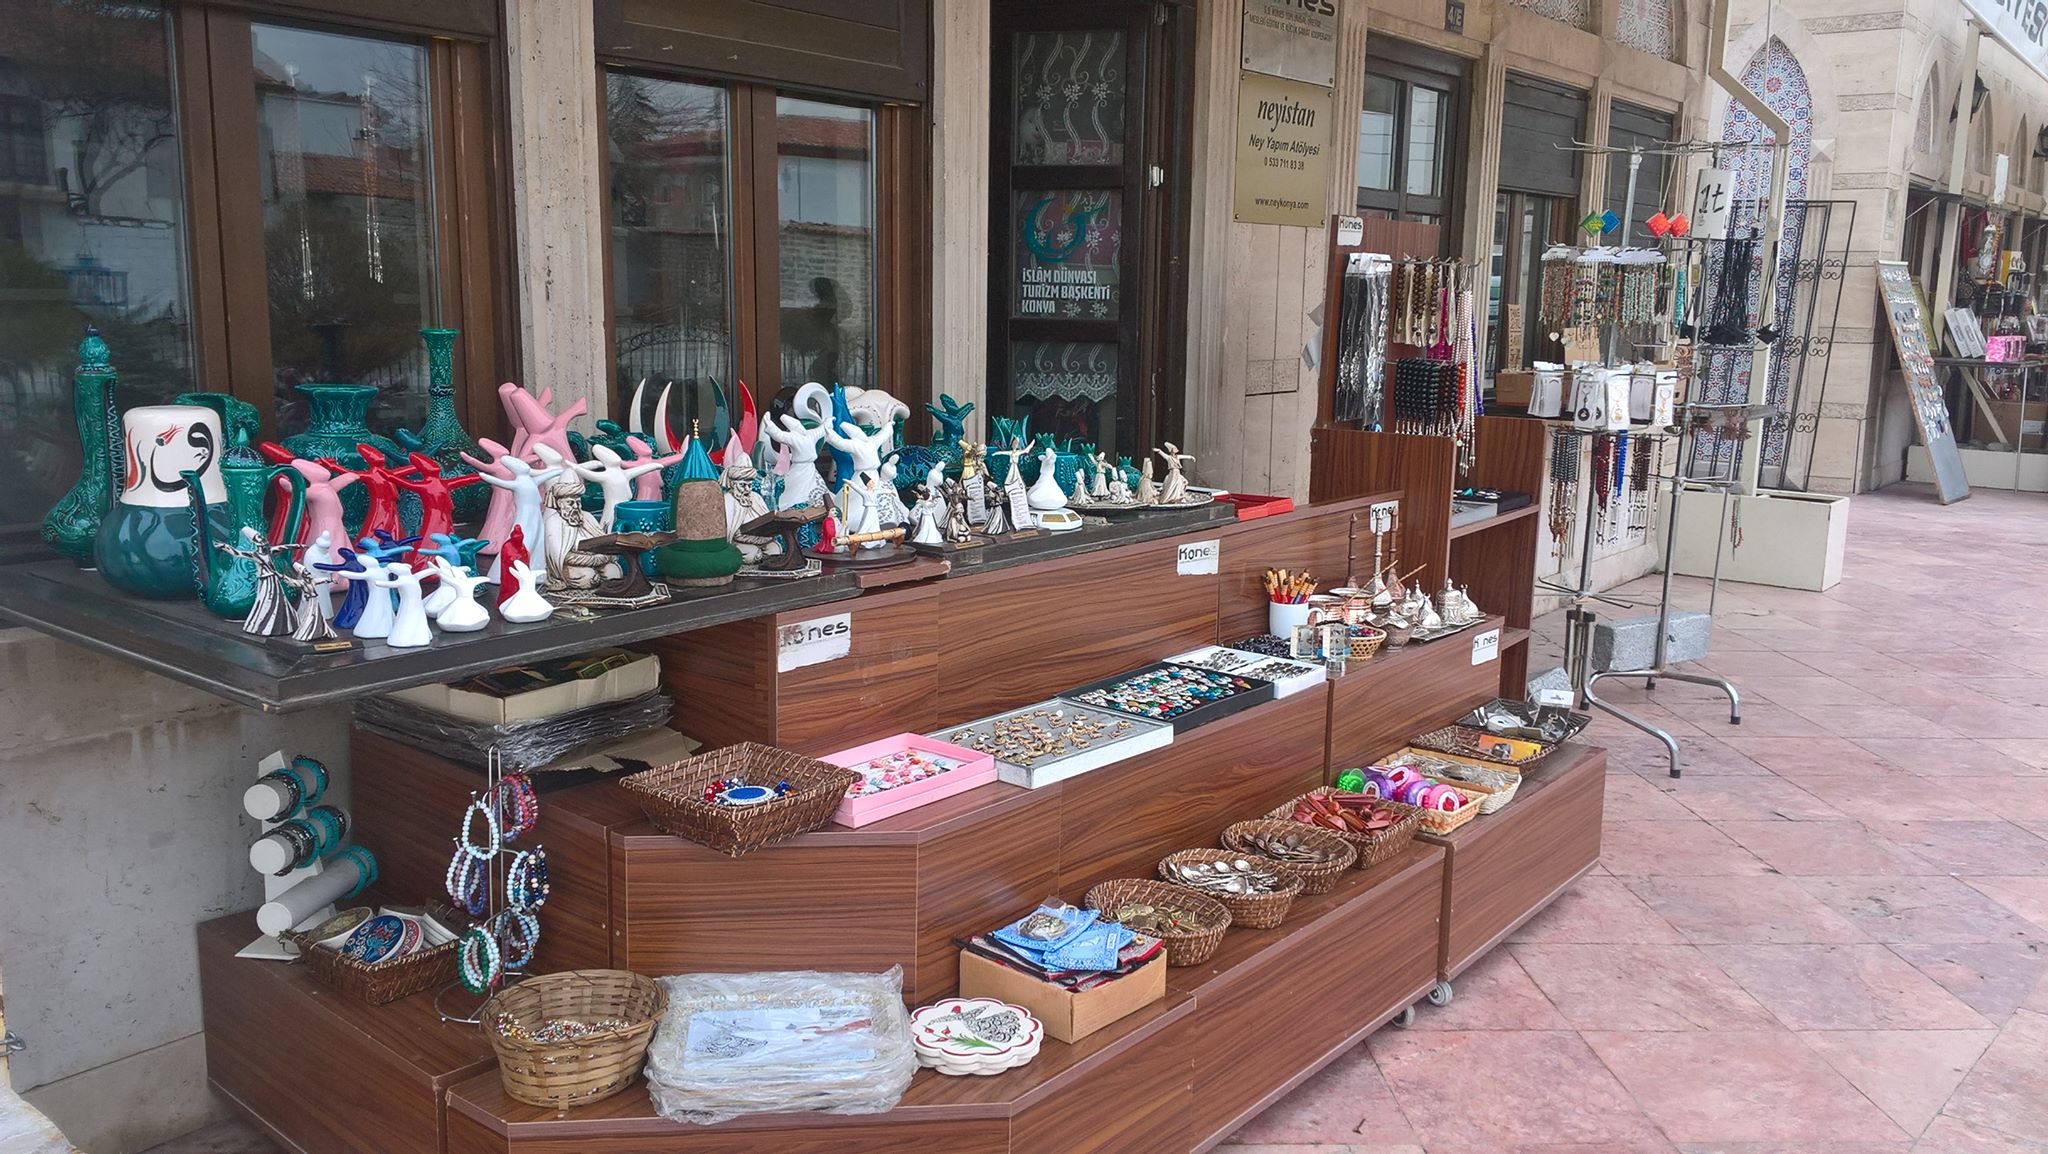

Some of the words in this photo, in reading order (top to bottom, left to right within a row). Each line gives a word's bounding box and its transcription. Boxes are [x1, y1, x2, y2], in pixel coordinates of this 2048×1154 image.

[1257, 95, 1316, 132] neyistan
[1248, 133, 1265, 151] Ney
[1266, 136, 1289, 153] Yapım
[1289, 140, 1321, 157] Atölyesi
[1264, 156, 1268, 167] 0
[1269, 157, 1279, 167] 533
[1280, 158, 1289, 169] 711
[1255, 197, 1310, 210] www.neykonya.com
[1022, 266, 1052, 283] İSLÂM
[1053, 267, 1097, 284] DÜNYASI
[1022, 283, 1059, 298] TURİZM
[1061, 285, 1110, 302] BAŞKENTİ
[1021, 299, 1056, 314] KONYA
[1179, 546, 1217, 561] Kone
[1473, 634, 1498, 649] Knes
